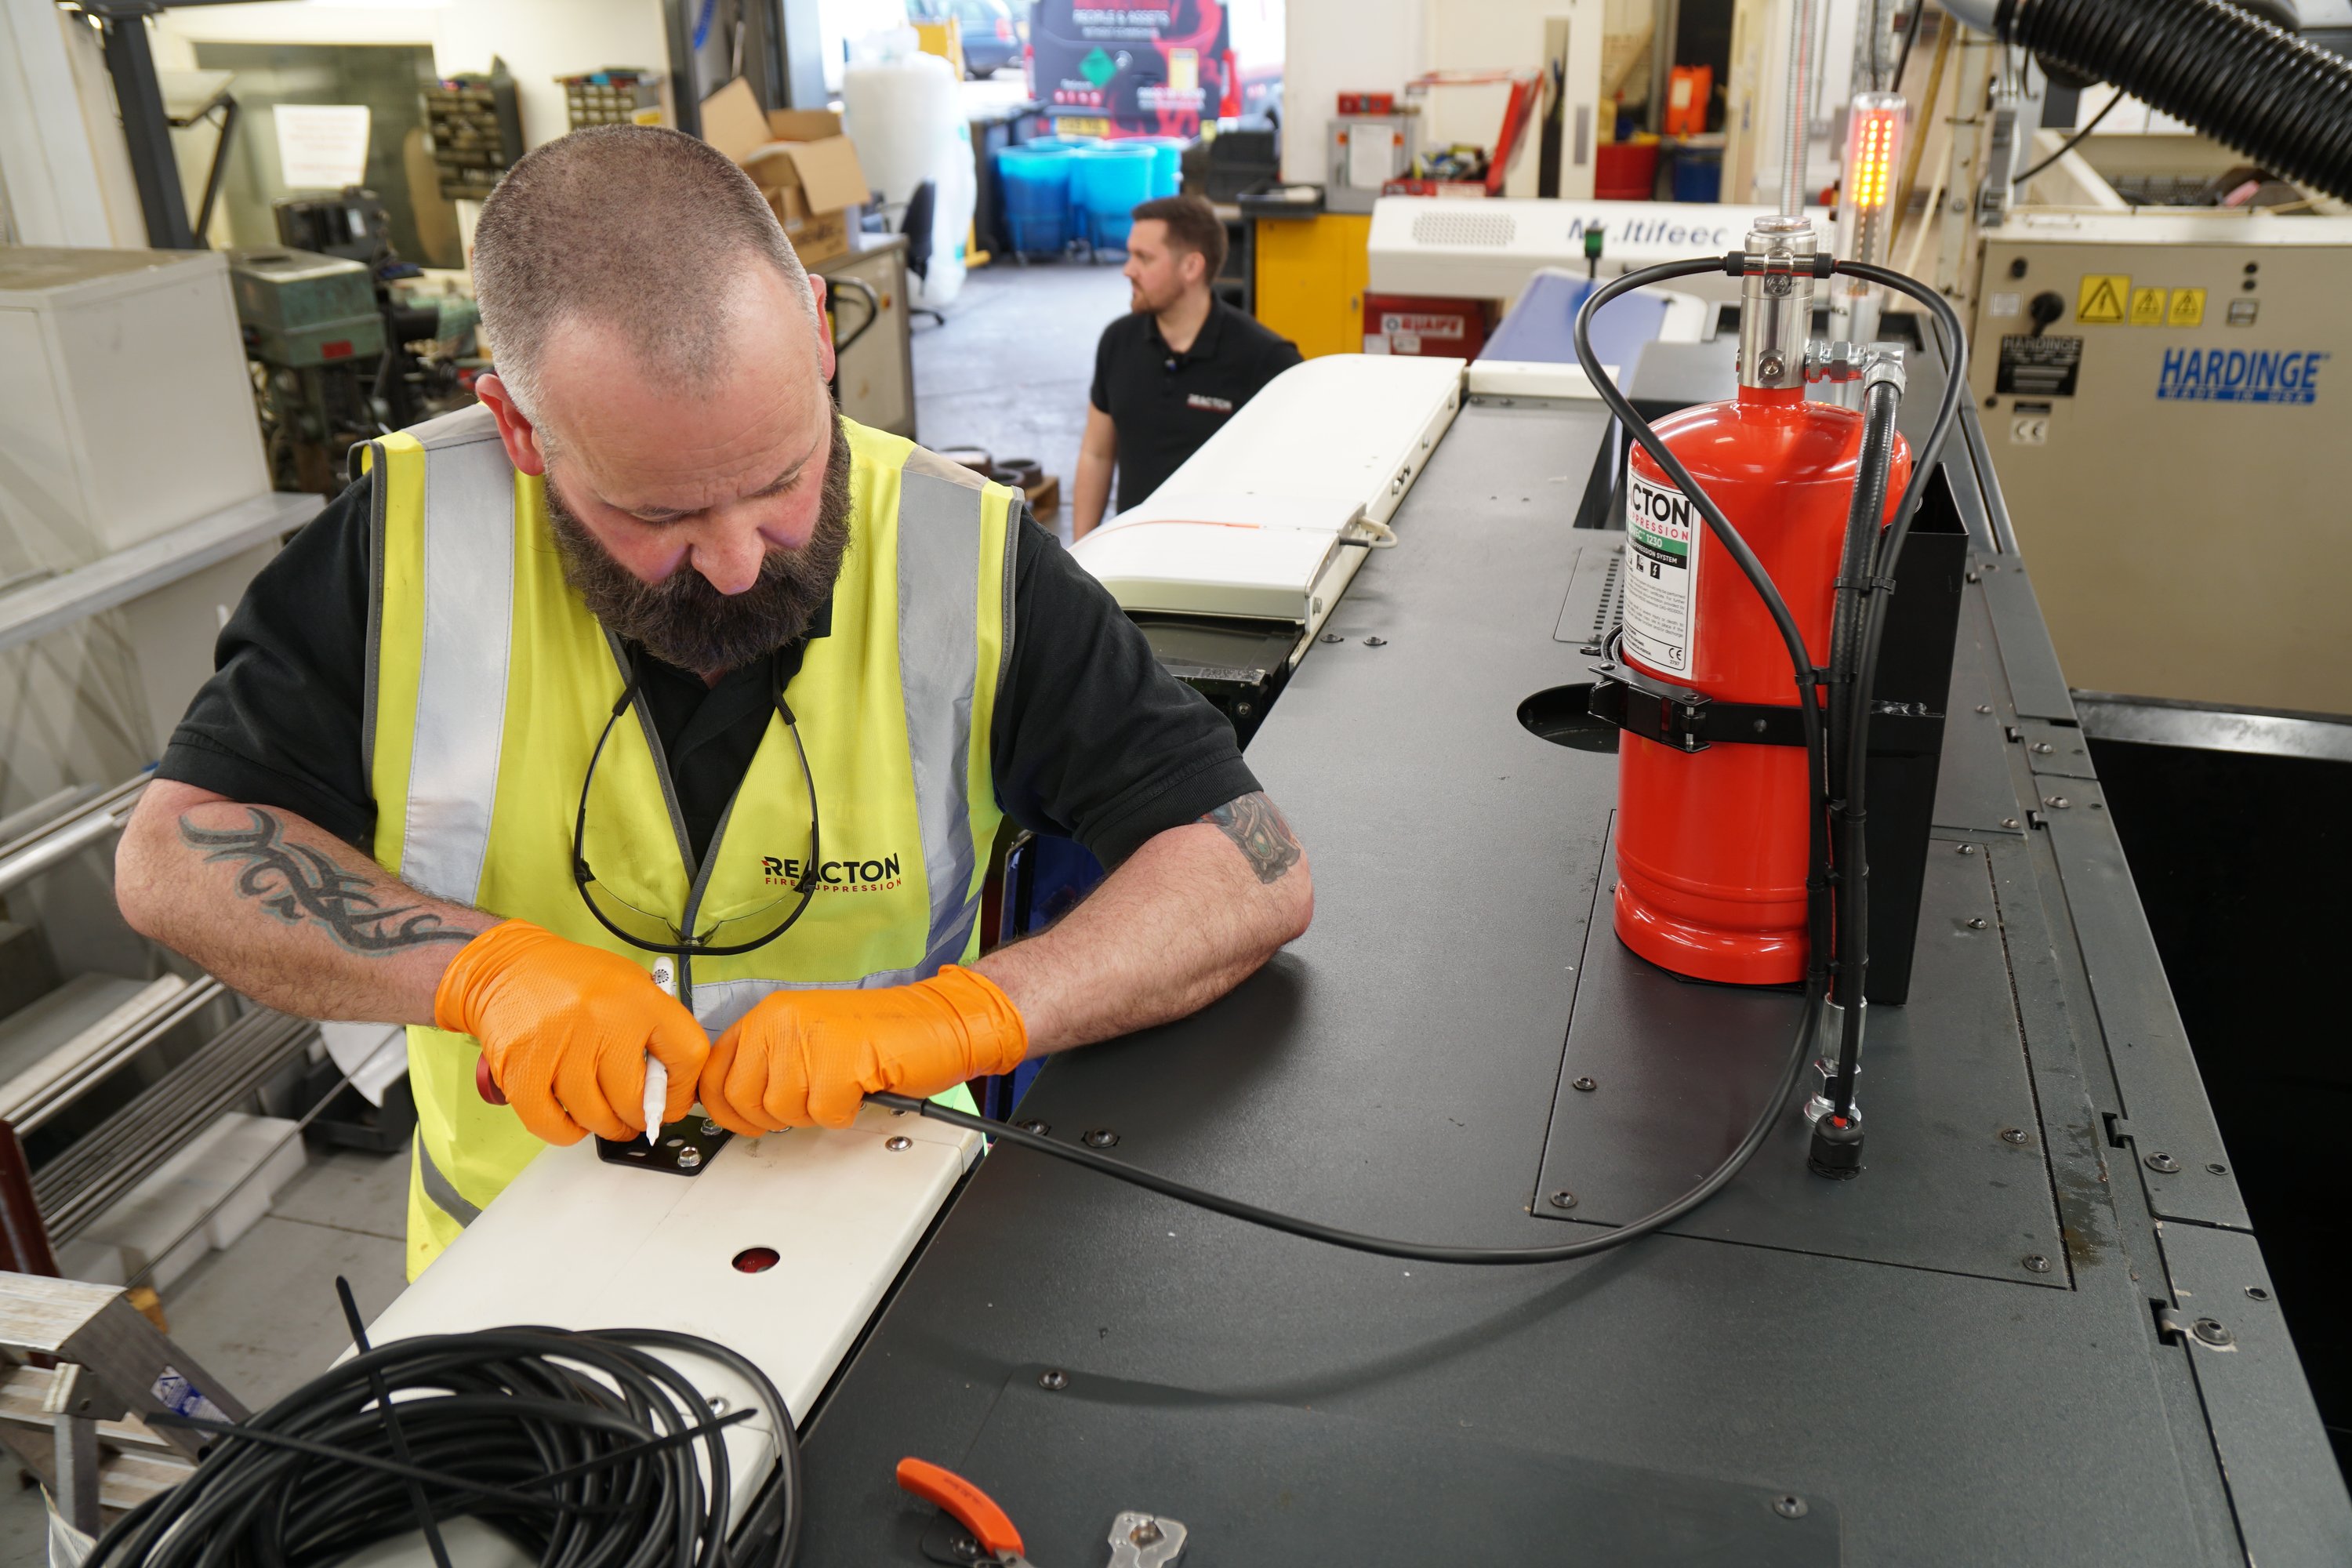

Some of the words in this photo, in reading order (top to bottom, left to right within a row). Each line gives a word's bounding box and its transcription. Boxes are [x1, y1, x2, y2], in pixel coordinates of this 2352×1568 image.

[1568, 218, 1729, 245] Mltifee
[2159, 347, 2321, 389] HARDINGE
[1631, 512, 1689, 541] PPRESSION
[1646, 534, 1663, 548] 1230
[1657, 552, 1678, 564] SYSTEM
[765, 877, 796, 887] FIRE
[814, 877, 902, 892] UPPRESSION
